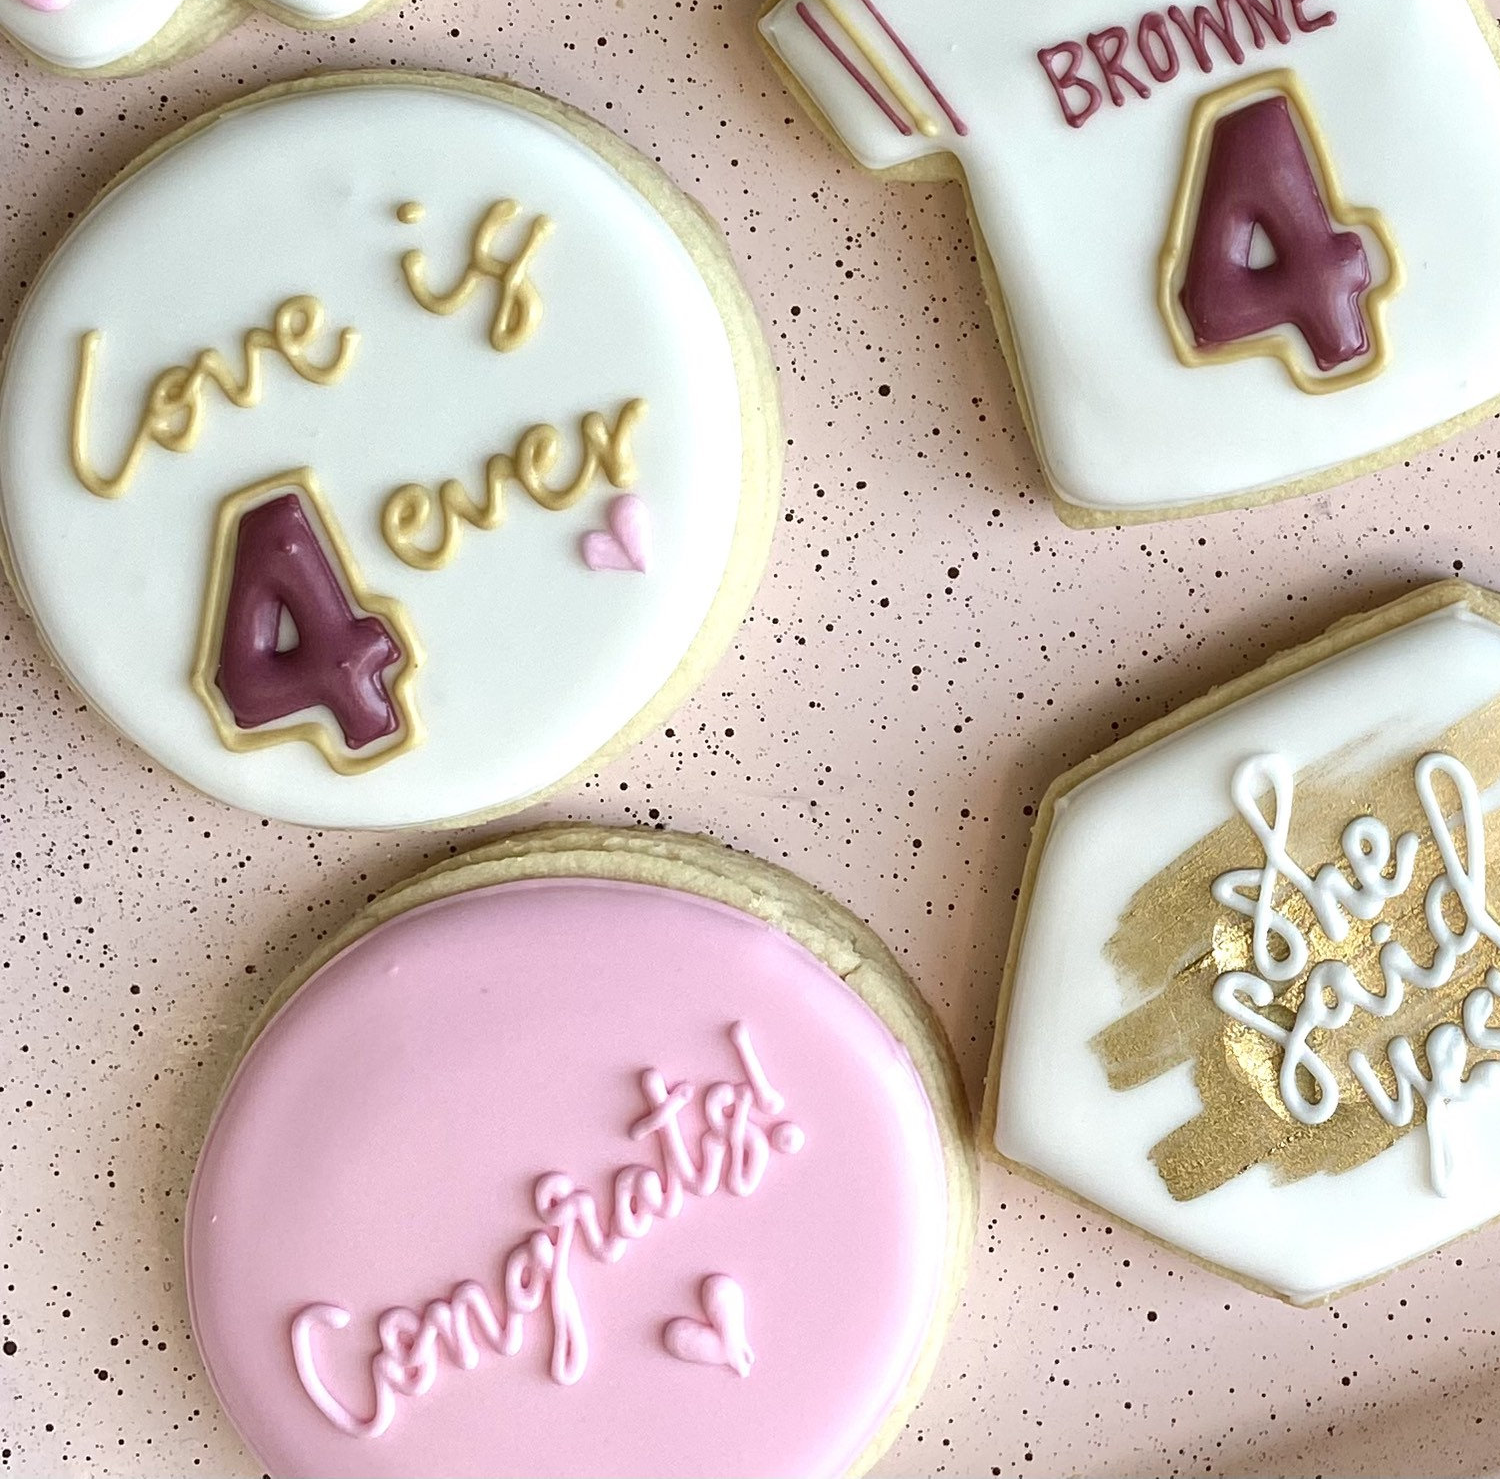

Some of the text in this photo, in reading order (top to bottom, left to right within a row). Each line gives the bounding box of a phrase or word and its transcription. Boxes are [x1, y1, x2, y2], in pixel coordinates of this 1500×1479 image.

[396, 198, 553, 353] is
[1166, 79, 1391, 385] 4
[202, 397, 650, 764] 4 ever
[1211, 752, 1419, 981] She
[292, 1020, 806, 1438] Congrats!
